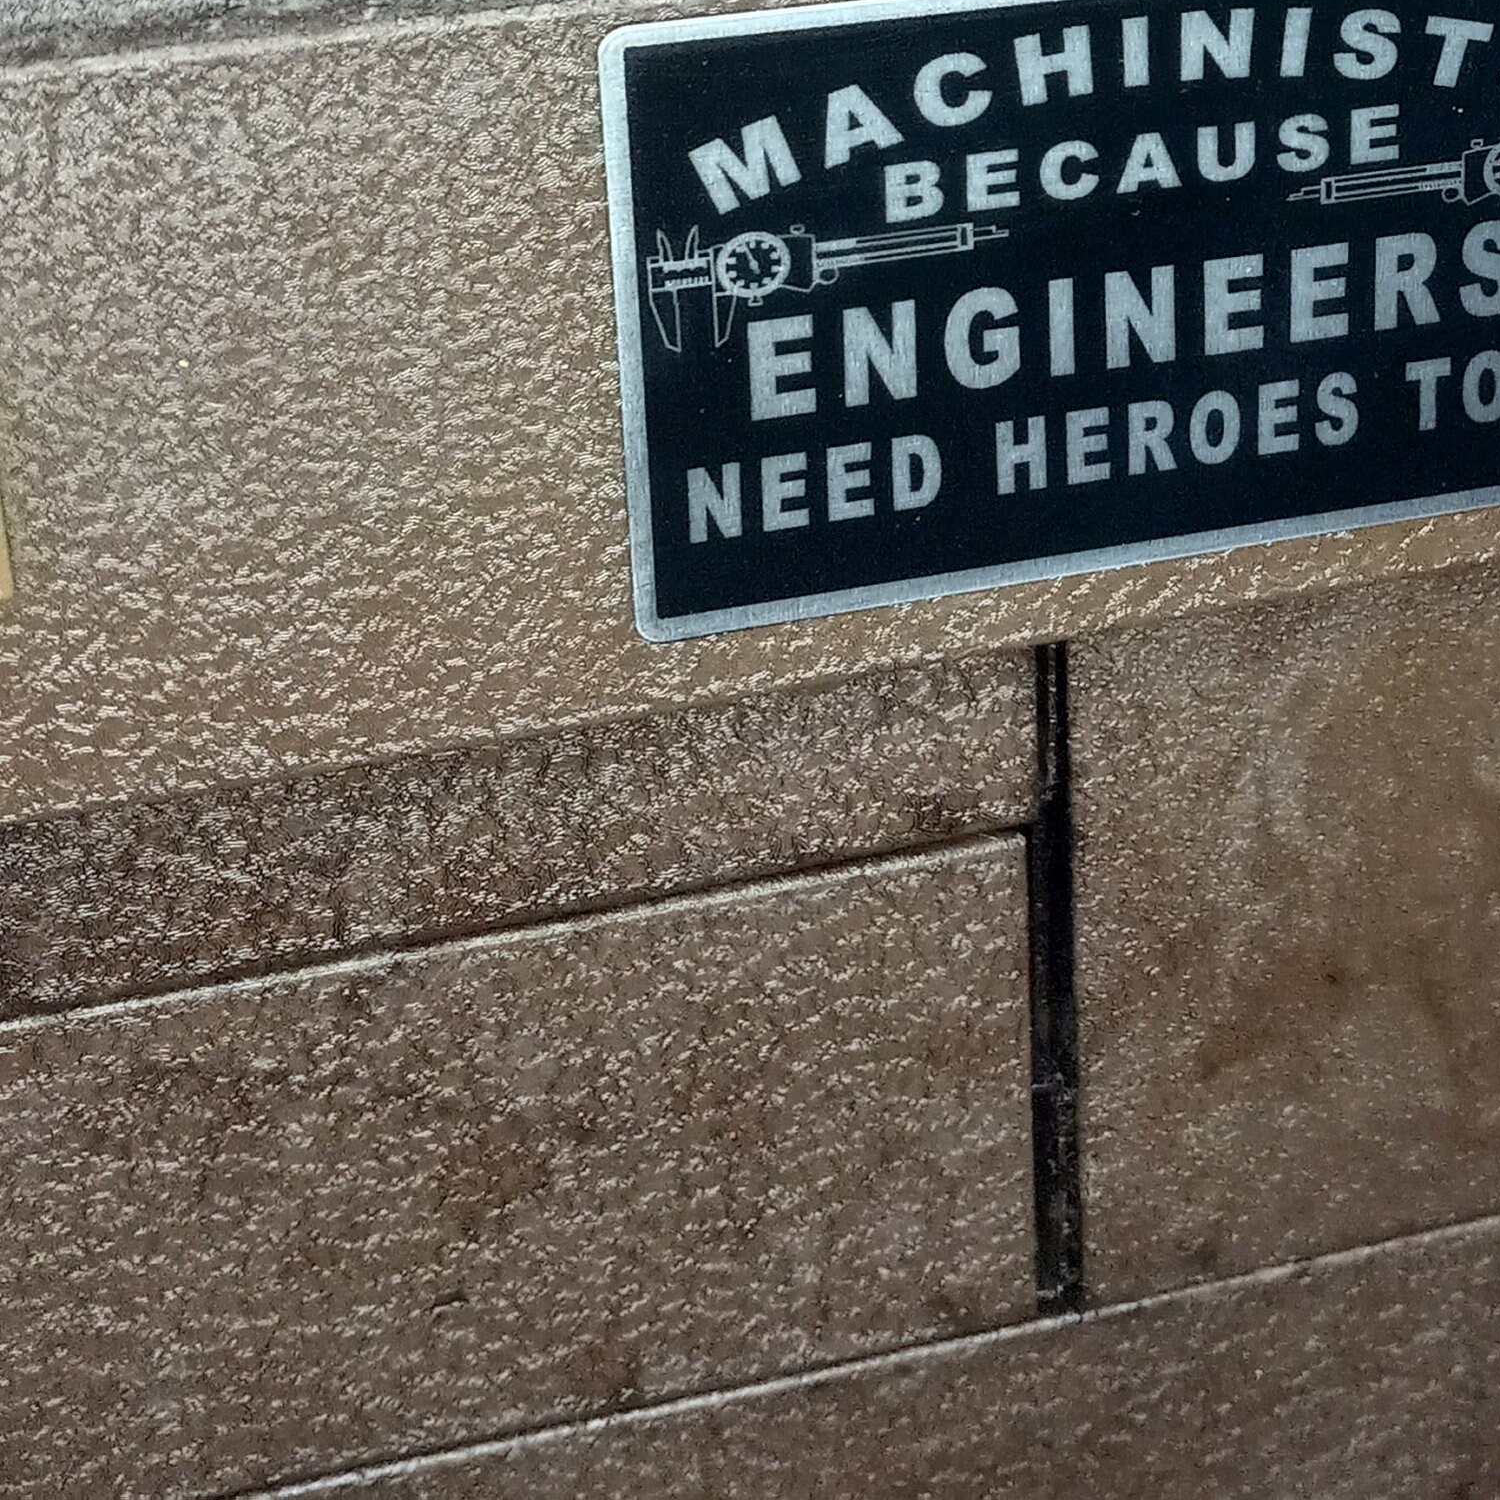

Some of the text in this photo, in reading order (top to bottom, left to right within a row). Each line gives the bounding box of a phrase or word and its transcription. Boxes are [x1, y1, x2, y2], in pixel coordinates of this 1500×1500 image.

[883, 102, 1401, 225] BECAUSE
[686, 433, 943, 545] NEED
[994, 370, 1360, 496] HEROES
